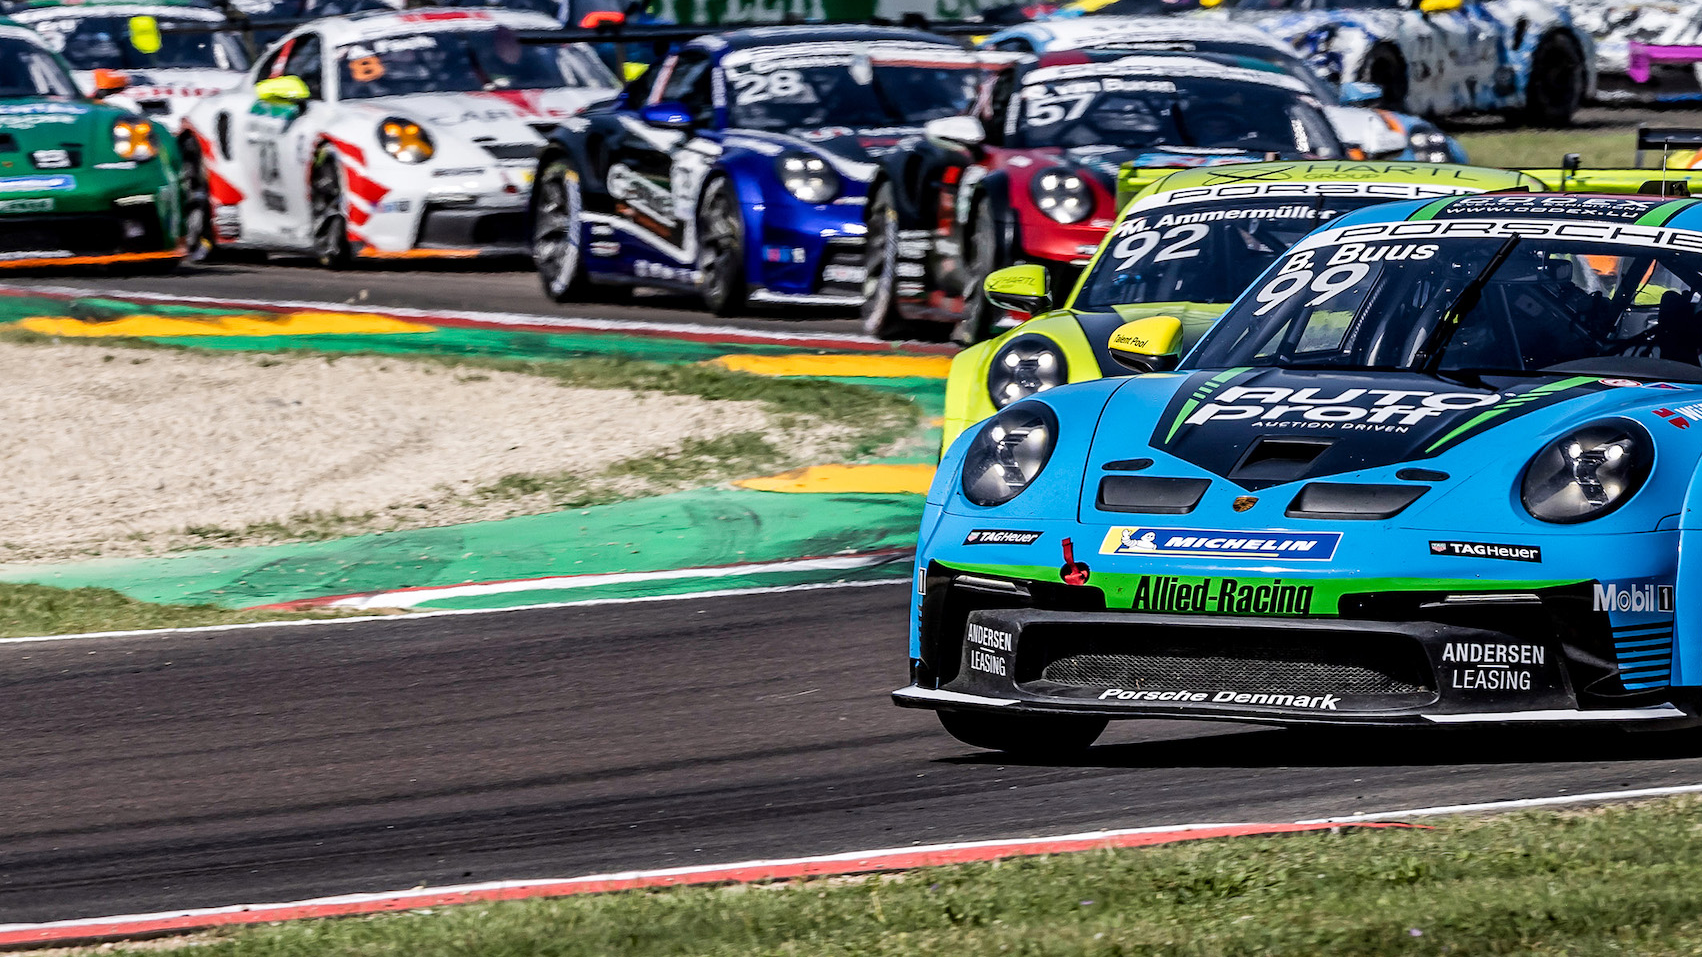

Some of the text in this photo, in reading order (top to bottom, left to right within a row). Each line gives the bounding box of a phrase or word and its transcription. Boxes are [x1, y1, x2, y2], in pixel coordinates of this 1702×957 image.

[735, 69, 804, 105] 28
[1027, 94, 1097, 126] 57
[1304, 172, 1380, 181] GROUP
[1305, 164, 1480, 181] HARTL
[1158, 205, 1337, 227] Ammermüller
[1112, 223, 1211, 273] 92
[1277, 243, 1440, 277] B. Buus
[1251, 263, 1371, 317] 99
[1113, 334, 1149, 349] Talent Pool
[1214, 386, 1501, 410] AUTO
[1252, 421, 1411, 433] AUCTION DRIVEN
[1164, 536, 1318, 552] MICHELIN
[1131, 575, 1314, 616] Allied-Racing
[1592, 583, 1655, 612] Mobil
[967, 623, 1013, 652] ANDERSEN
[970, 649, 1006, 677] LEASING
[1442, 642, 1545, 665] ANDERSEN
[1452, 669, 1531, 691] LEASING
[1099, 688, 1342, 710] Porsche Denmark
